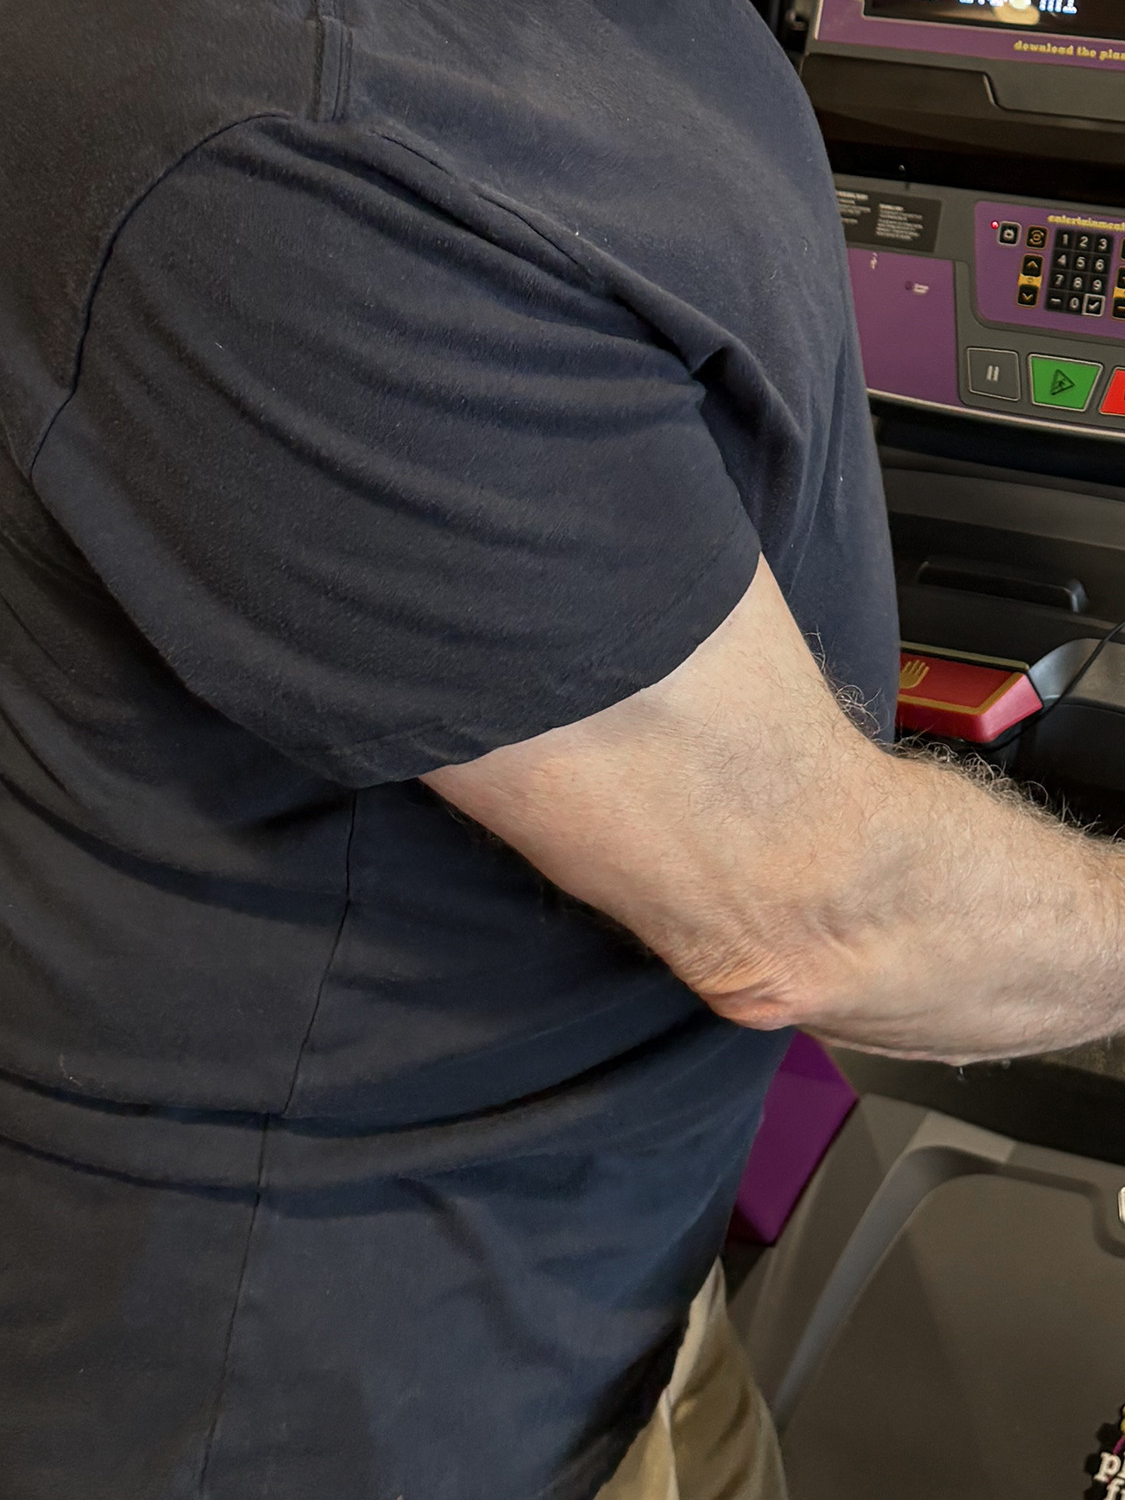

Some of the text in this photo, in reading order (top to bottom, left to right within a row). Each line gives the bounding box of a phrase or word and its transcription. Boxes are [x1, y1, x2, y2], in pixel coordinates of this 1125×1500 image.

[1014, 40, 1074, 56] download
[1076, 46, 1096, 58] the
[1047, 215, 1125, 232] entertainment
[1062, 234, 1108, 251] 1 2 3
[1058, 254, 1104, 271] 4 5 6
[1055, 274, 1102, 291] 7 8 9
[1070, 297, 1079, 309] 0
